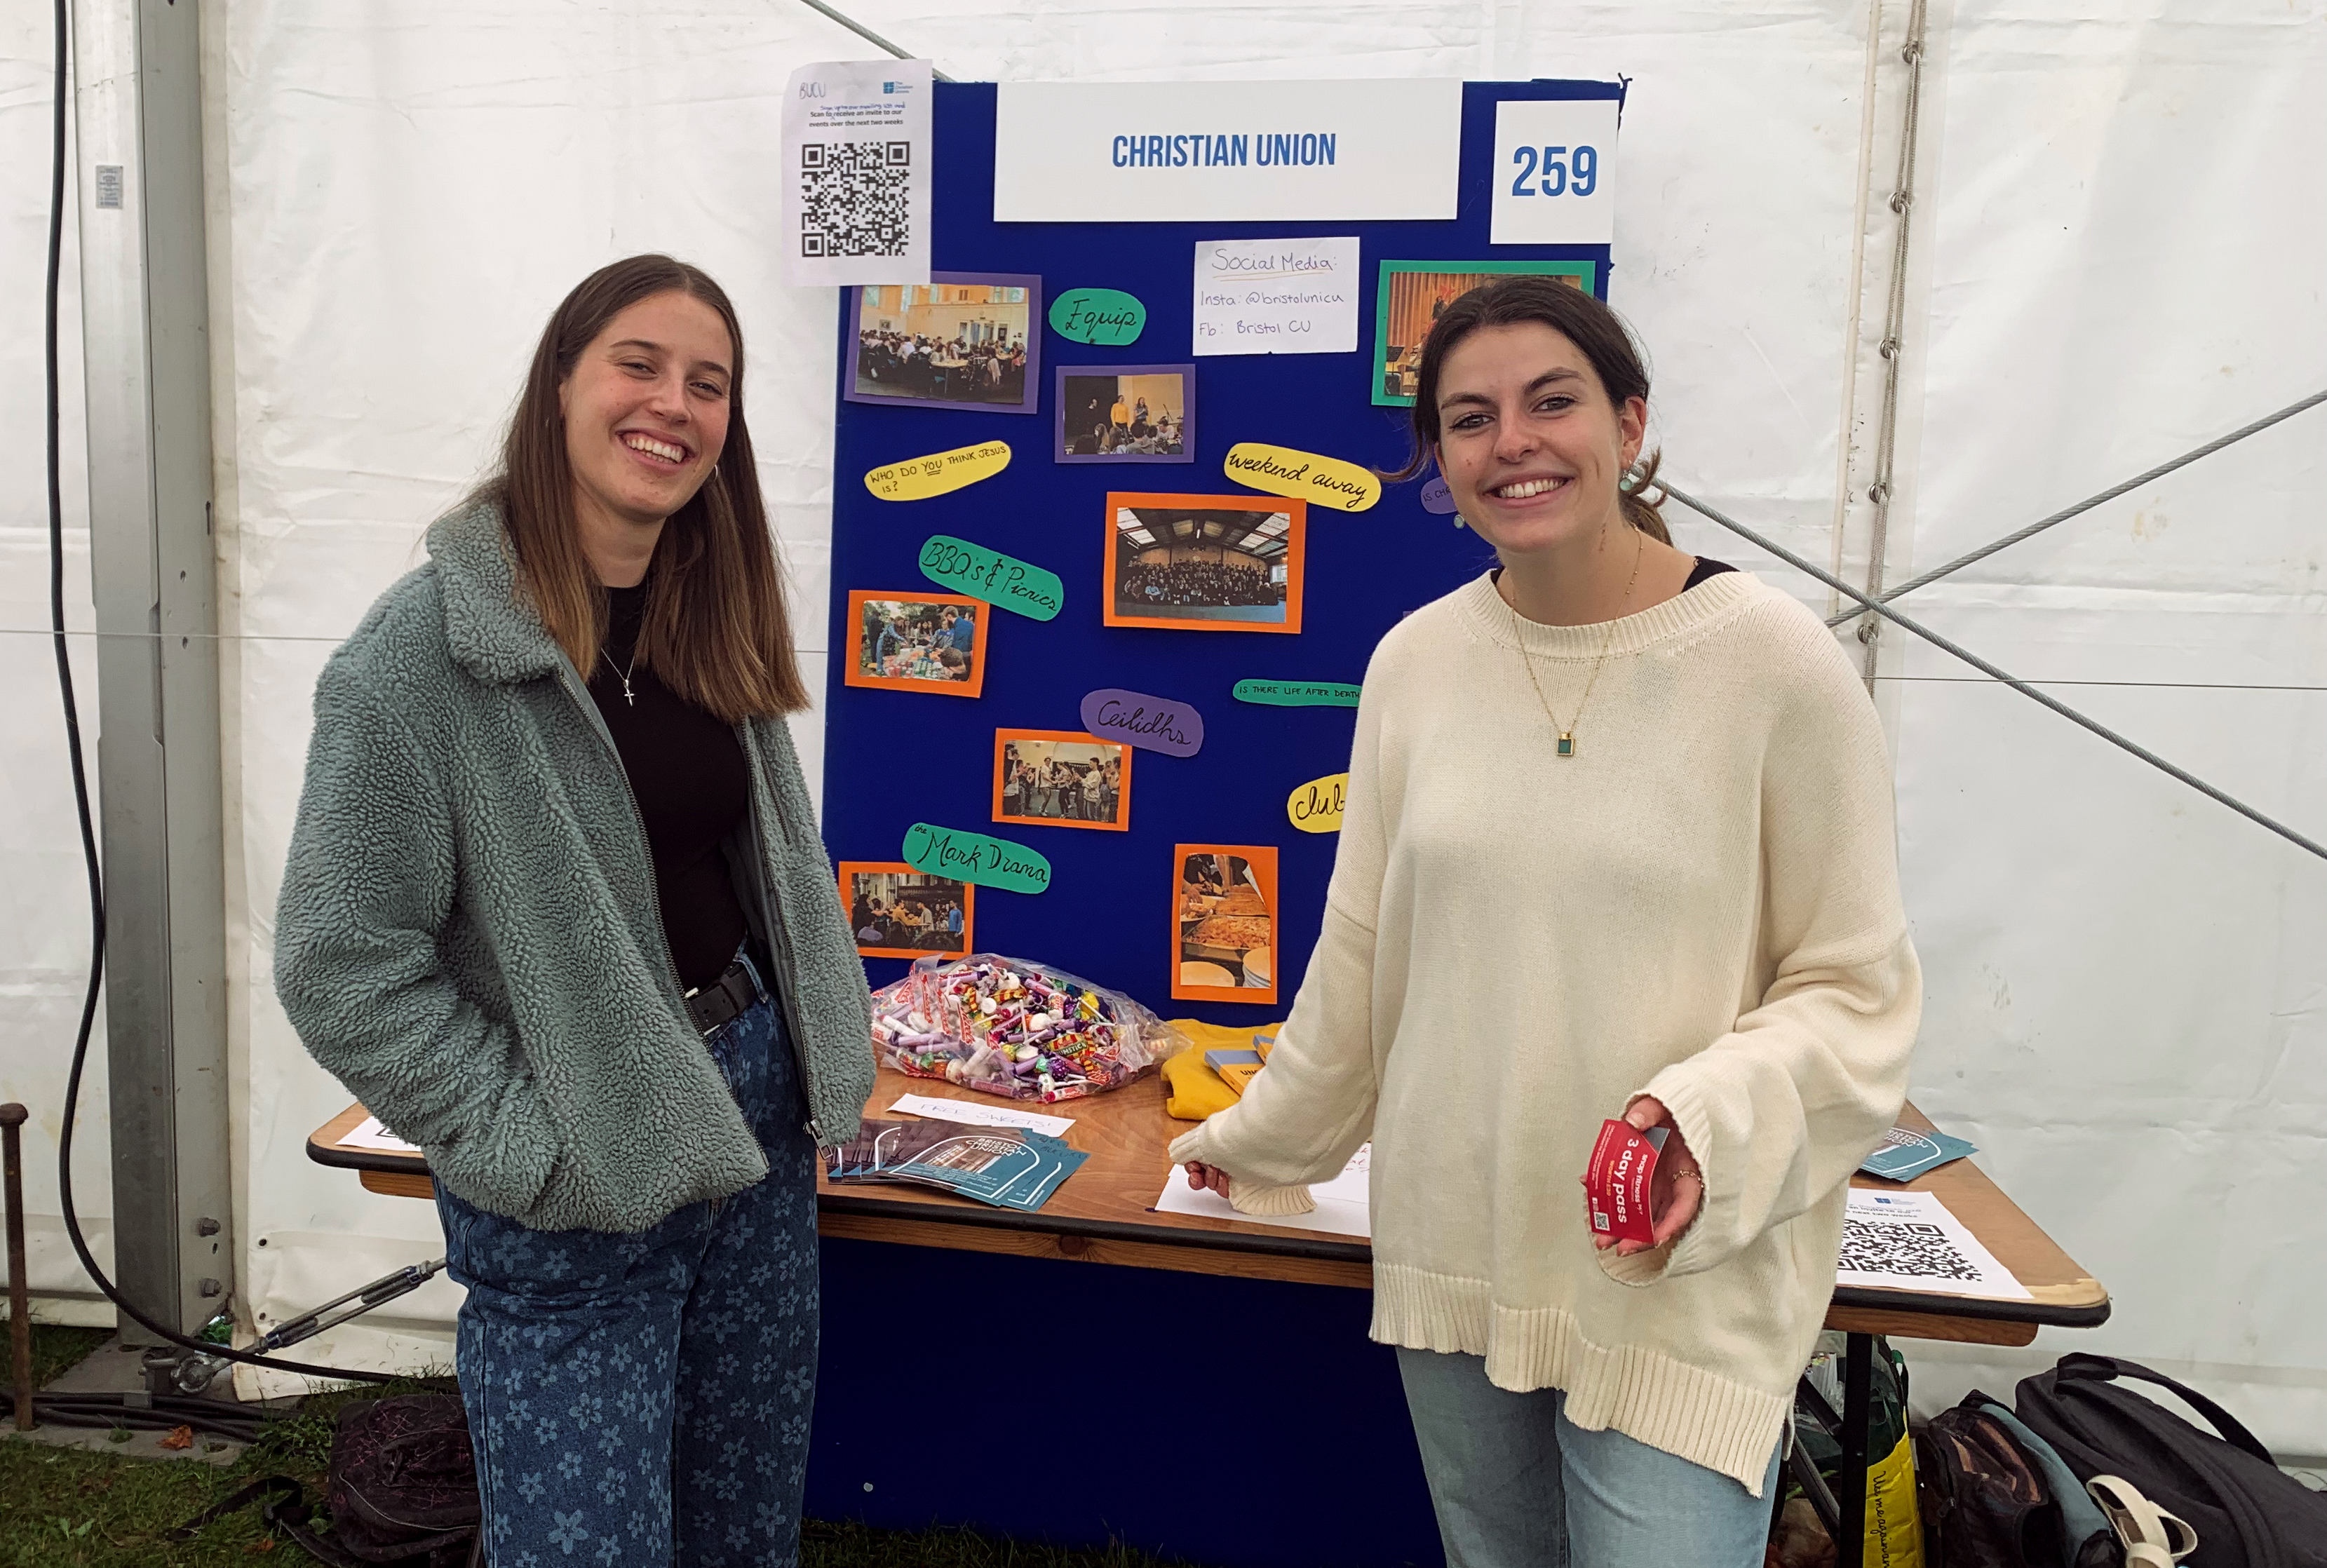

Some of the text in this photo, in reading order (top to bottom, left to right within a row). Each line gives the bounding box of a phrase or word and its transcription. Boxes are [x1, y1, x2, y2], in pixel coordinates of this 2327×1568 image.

[800, 82, 825, 100] BUCU
[1113, 133, 1336, 167] CHRISTIAN UNION
[1512, 146, 1597, 196] 259
[1212, 249, 1275, 270] Social
[1201, 291, 1241, 306] Insta:
[1065, 299, 1136, 337] Equip
[1200, 320, 1311, 336] Fb: Bristol CU
[870, 446, 1006, 483] WHO DO YOU THINK JESUS
[882, 480, 898, 493] IS?
[1229, 454, 1367, 508] weekend away
[1423, 487, 1451, 502] IS CHR
[922, 542, 985, 580] BBQ's
[1001, 567, 1056, 611] Picnics
[1305, 688, 1329, 696] AFTER
[1098, 701, 1192, 745] Ceilidhs
[914, 825, 927, 834] the
[917, 832, 982, 873] Mark
[921, 1104, 966, 1116] FREE
[966, 1140, 1027, 1156] CHRISTIAN
[971, 1144, 1013, 1156] UNION
[978, 1138, 1022, 1150] BRISTOL
[1635, 1154, 1648, 1173] snap
[1612, 1138, 1639, 1224] 3 day pass
[1634, 1175, 1643, 1203] fitness
[1870, 1471, 1892, 1568] Use me again an
